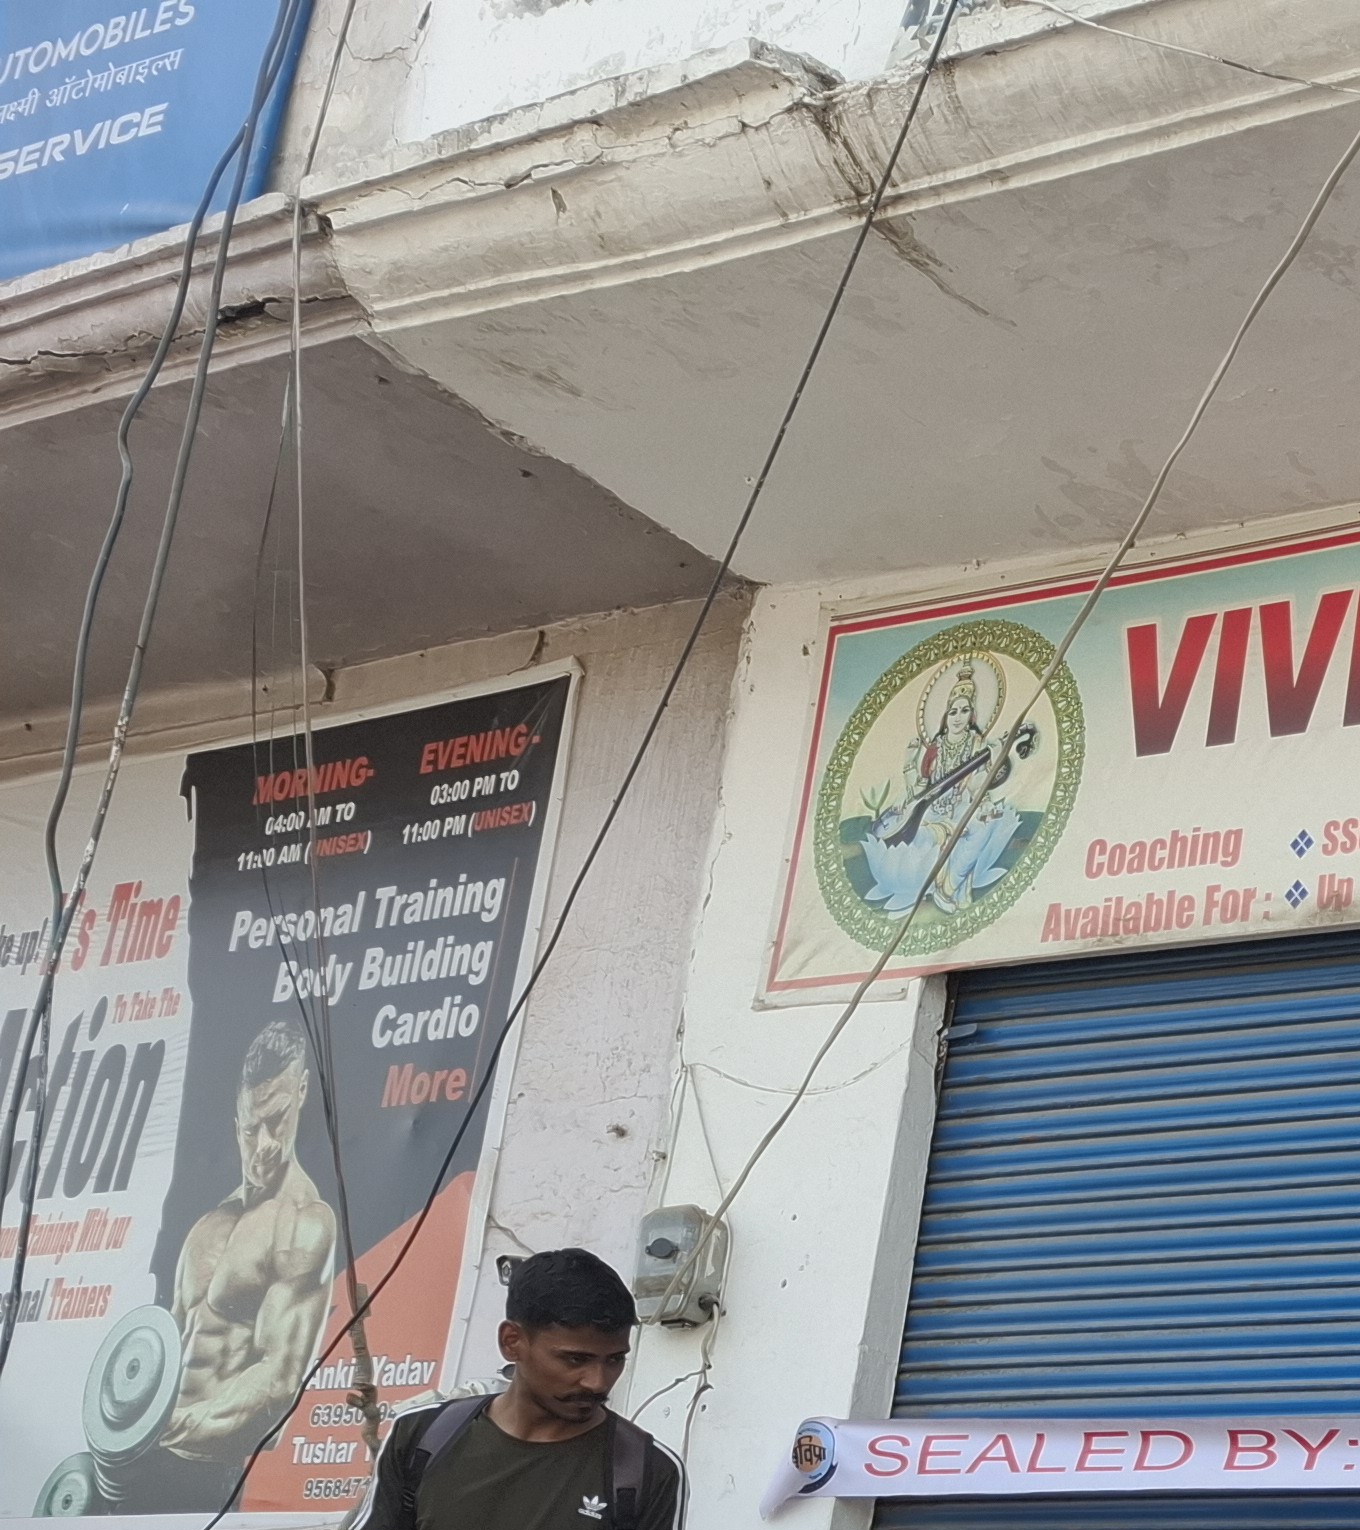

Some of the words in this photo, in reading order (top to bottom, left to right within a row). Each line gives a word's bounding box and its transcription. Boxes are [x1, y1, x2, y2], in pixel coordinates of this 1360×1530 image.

[46, 48, 185, 108] ऑटोमोबाइल्स
[0, 102, 169, 180] SERVICE
[430, 779, 470, 805] 03:00
[472, 774, 496, 797] PM
[500, 769, 519, 791] TO
[265, 811, 305, 835] 04:00
[336, 801, 355, 822] TO
[402, 819, 440, 844] 11:00
[442, 814, 466, 837] PM
[467, 800, 536, 838] (UNISEX)
[277, 843, 302, 864] AM
[1084, 827, 1244, 880] Coaching
[228, 890, 366, 951] Personal
[374, 874, 505, 928] Training
[1040, 894, 1196, 944] Available
[1204, 884, 1253, 927] For
[1316, 873, 1354, 912] Up
[99, 880, 181, 966] Time
[272, 955, 353, 1006] Body
[358, 936, 493, 990] Building
[371, 995, 480, 1049] Cardio
[380, 1063, 467, 1108] More
[47, 1275, 112, 1321] Trainers
[371, 1354, 436, 1387] Yadav
[292, 1436, 358, 1464] Tushar
[863, 1430, 1195, 1477] SEALED
[1223, 1427, 1360, 1472] BY:
